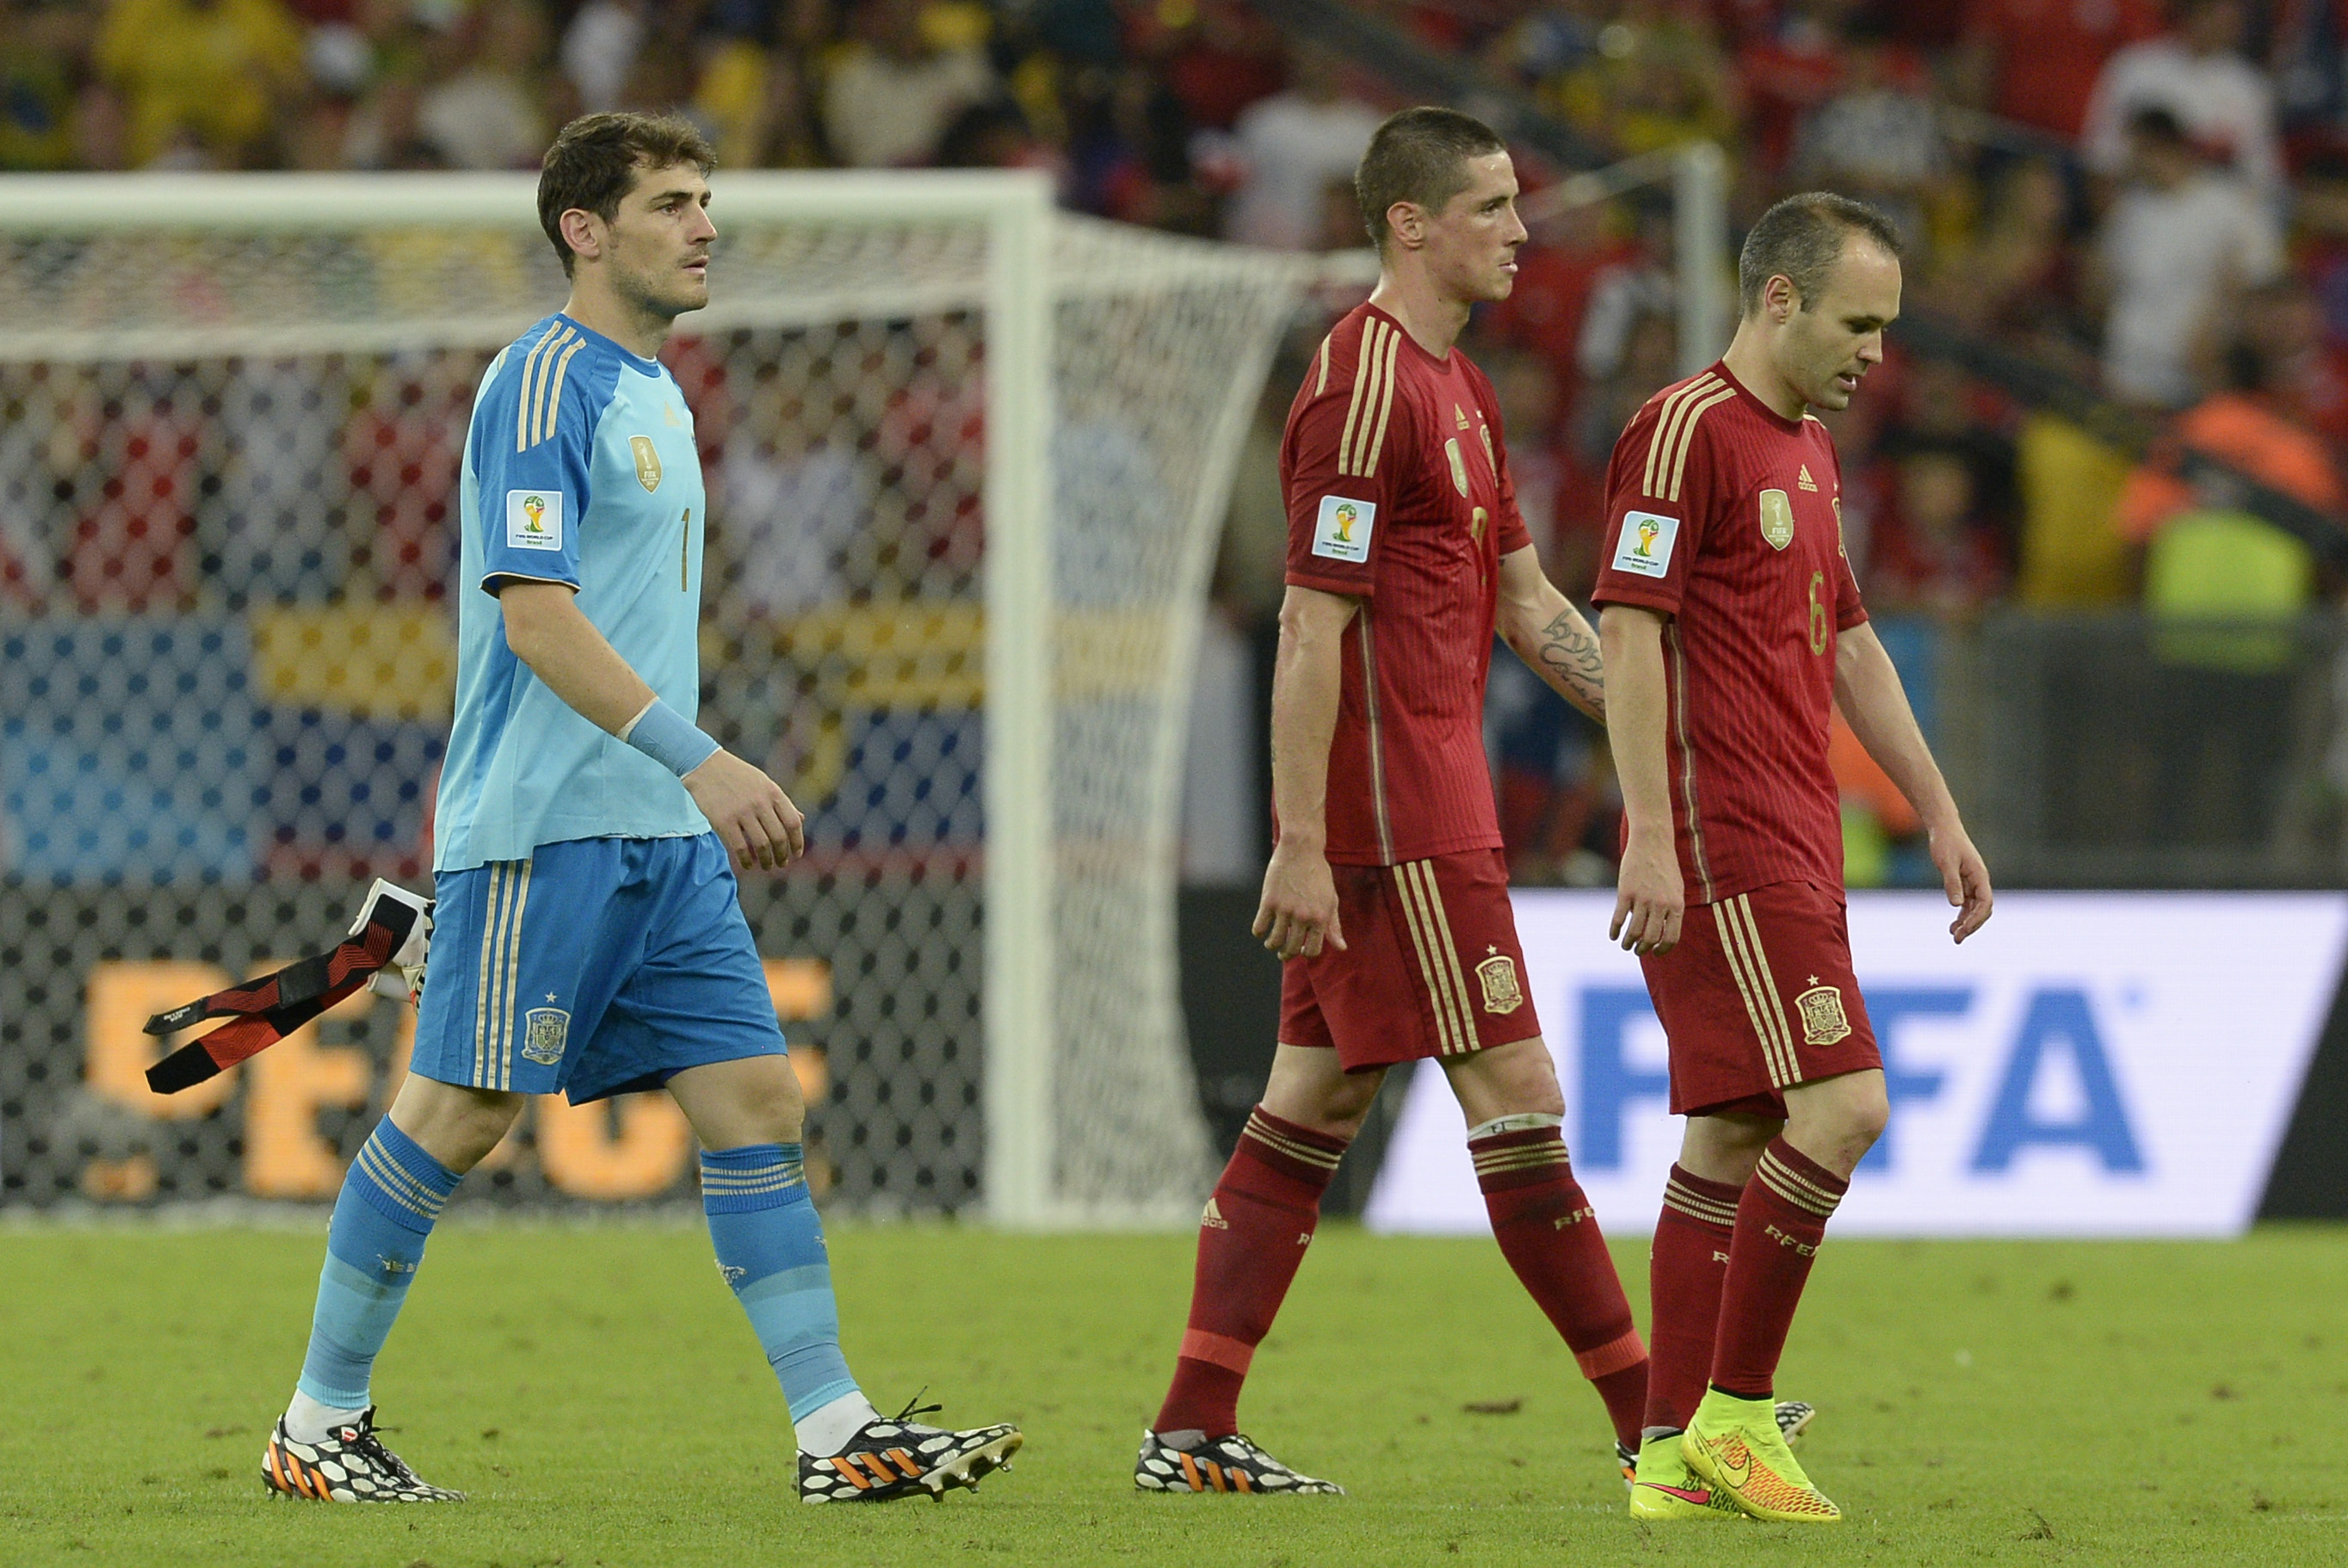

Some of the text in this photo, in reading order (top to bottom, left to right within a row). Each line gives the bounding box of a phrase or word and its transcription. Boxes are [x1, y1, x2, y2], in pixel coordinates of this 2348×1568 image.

[682, 508, 689, 591] 1
[1809, 570, 1827, 657] 6
[1579, 985, 2145, 1172] FFA
[1764, 1224, 1819, 1257] RFE
